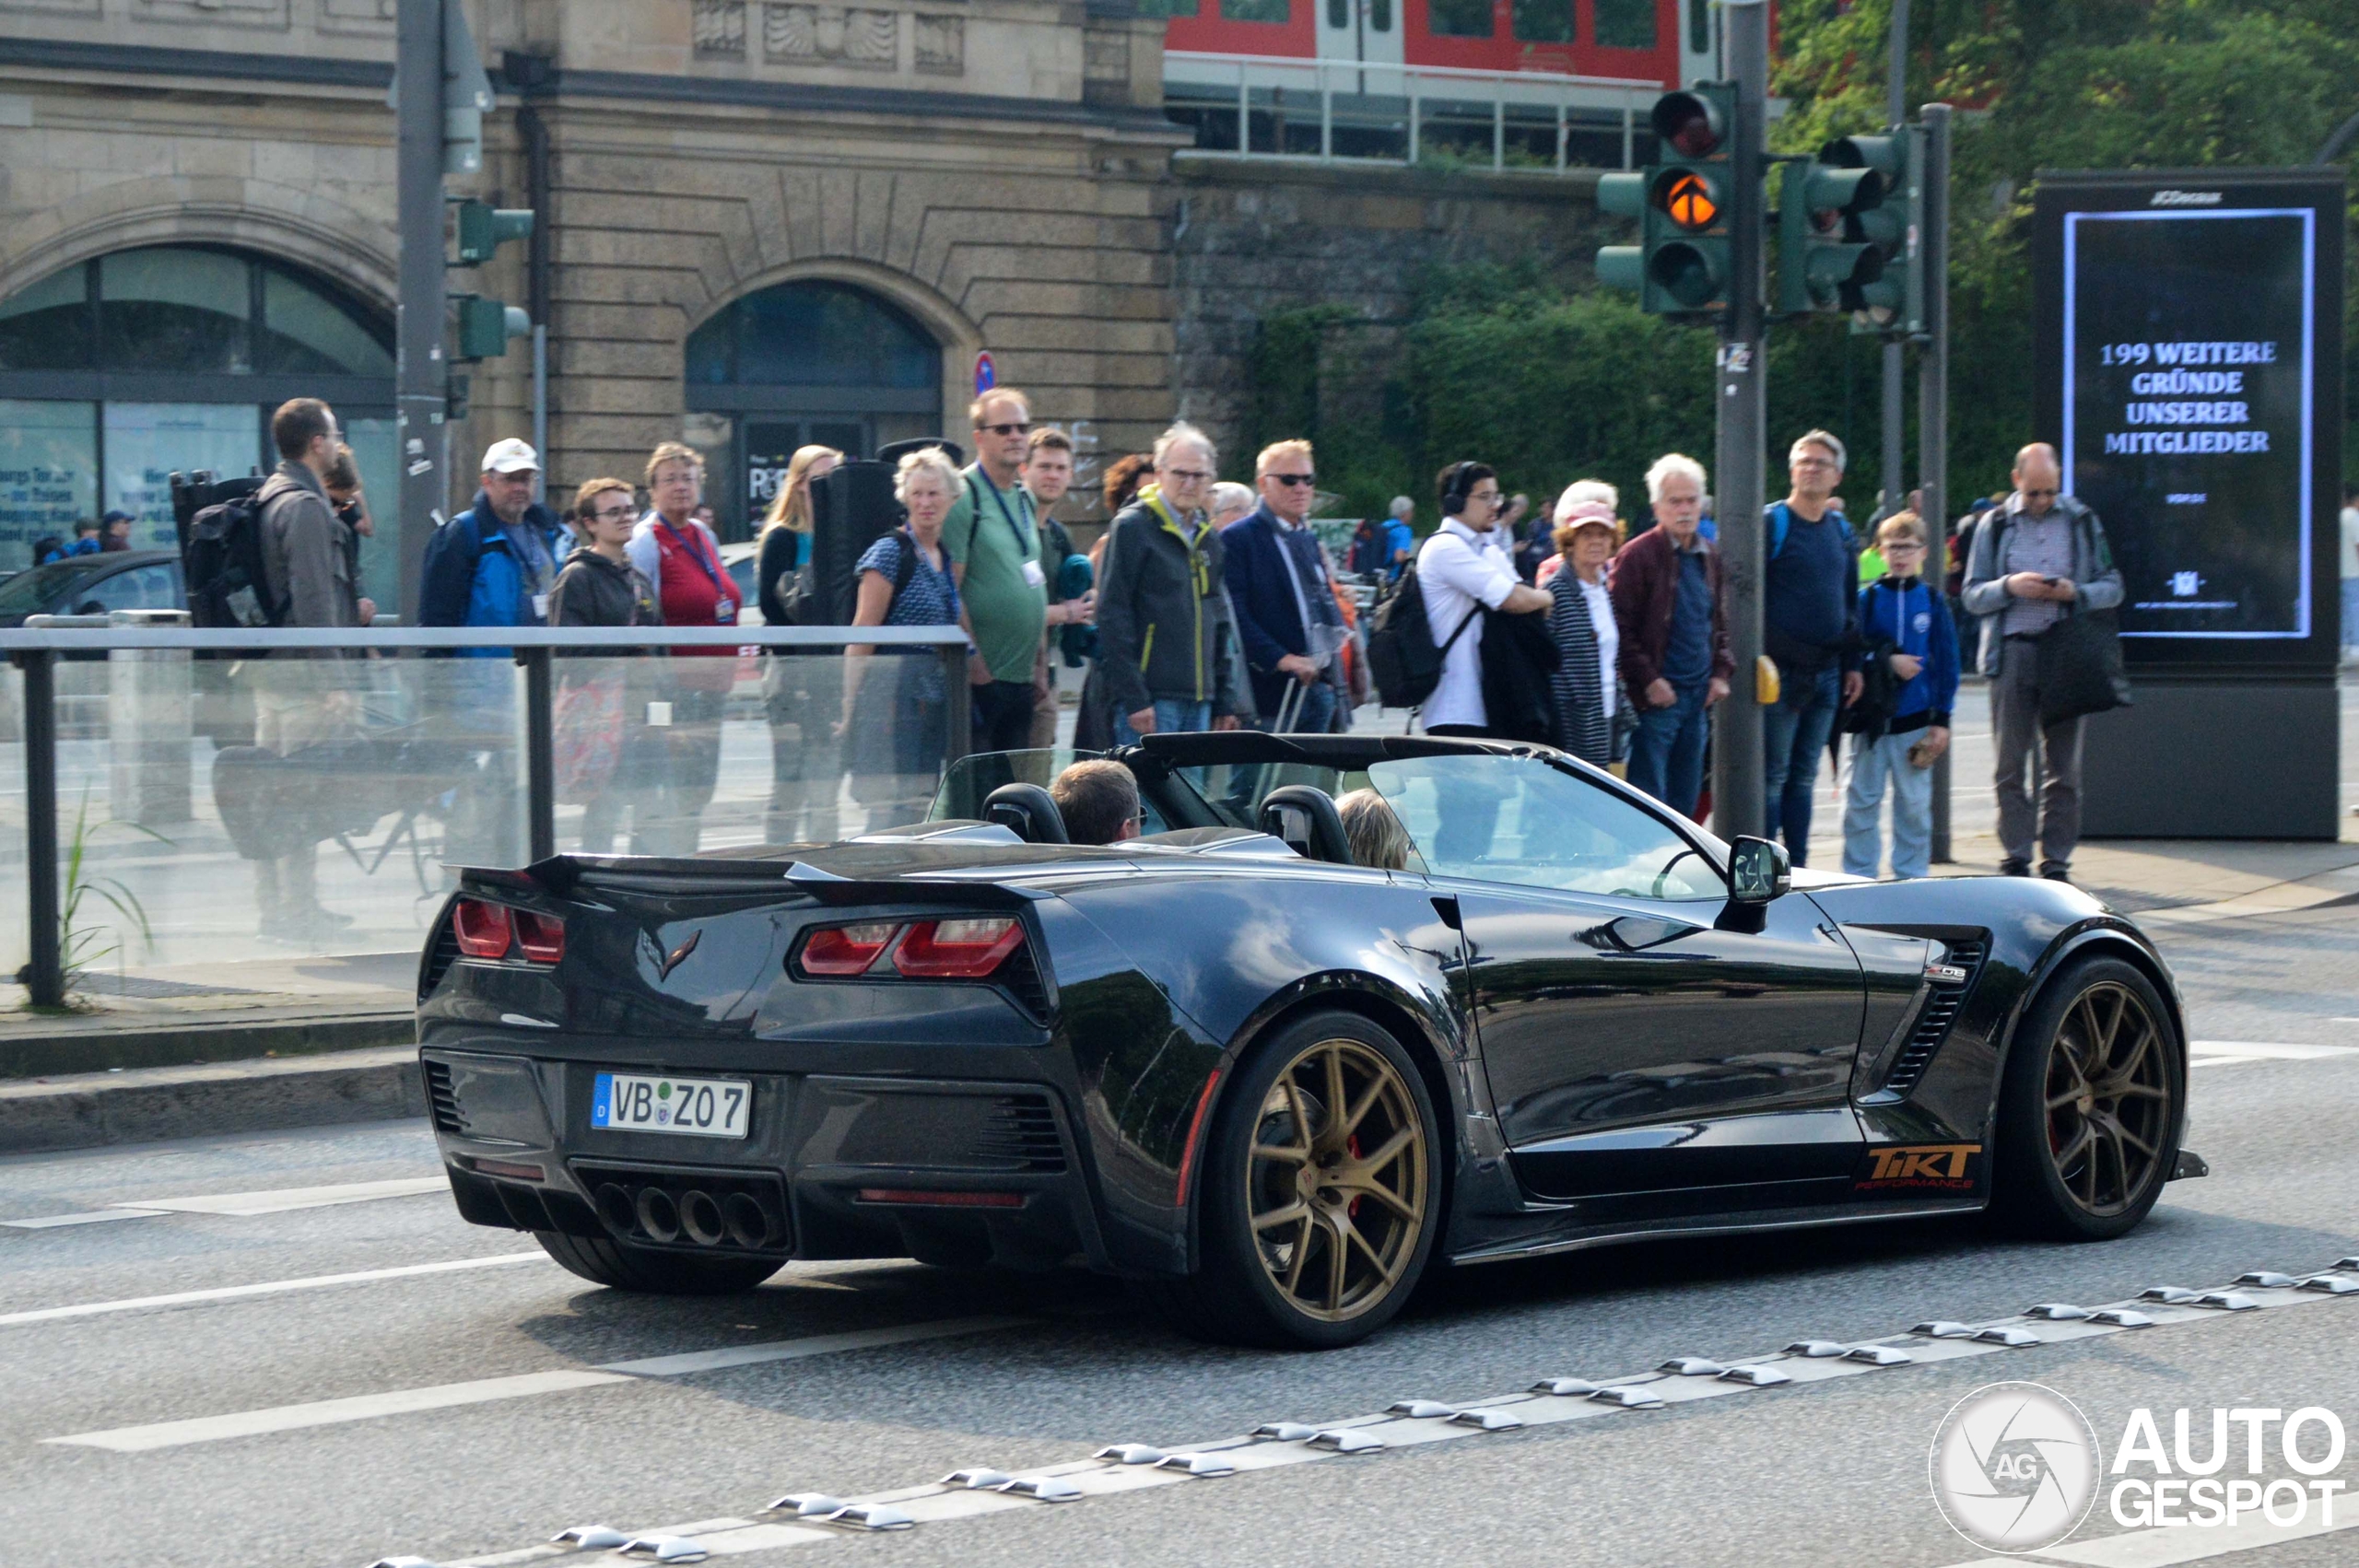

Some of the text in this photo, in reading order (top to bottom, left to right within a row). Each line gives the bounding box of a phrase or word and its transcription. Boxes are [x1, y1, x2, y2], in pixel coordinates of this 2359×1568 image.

[2101, 342, 2277, 365] 199 WEITERE
[2131, 368, 2244, 393] GRÜNDE
[2126, 402, 2249, 424] UNSERER
[2105, 431, 2270, 453] MITGLIEDER
[597, 1105, 605, 1117] D
[616, 1081, 652, 1123] VB
[724, 1088, 743, 1128] 7
[1855, 1179, 1975, 1190] PERFORMANCE
